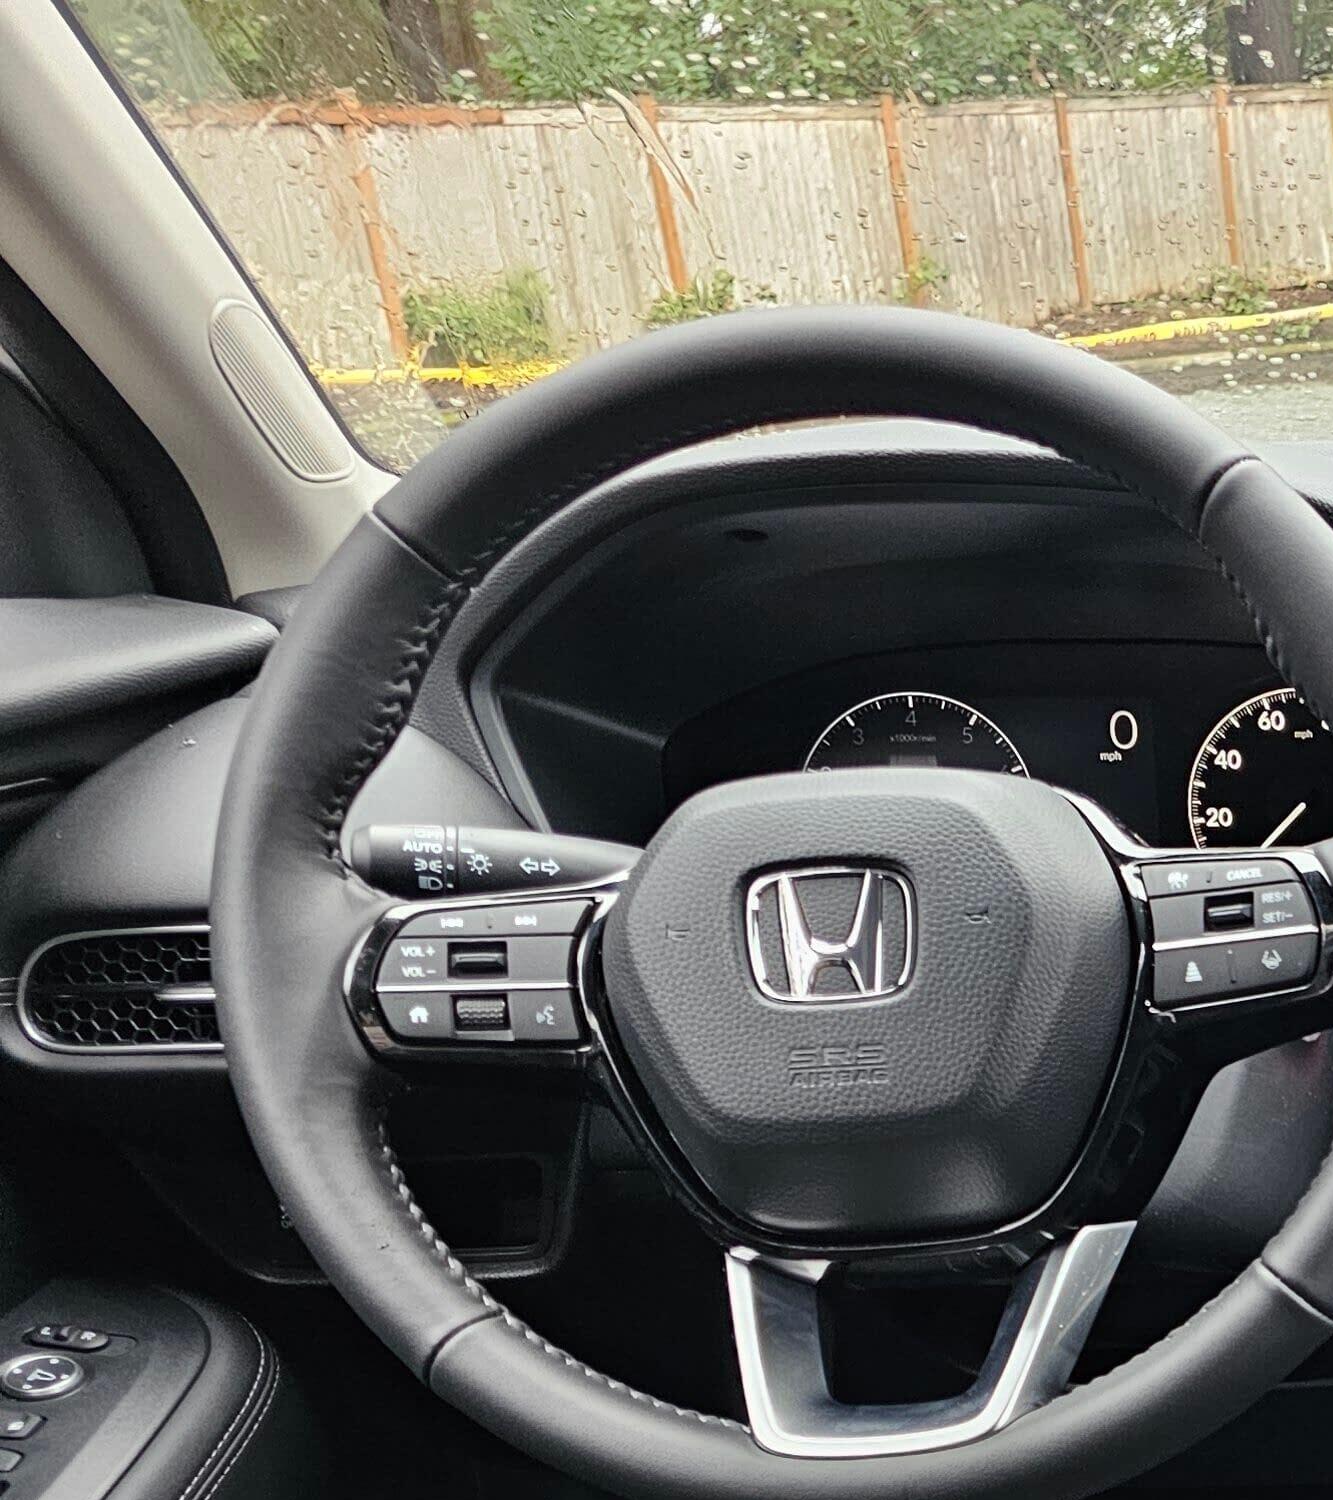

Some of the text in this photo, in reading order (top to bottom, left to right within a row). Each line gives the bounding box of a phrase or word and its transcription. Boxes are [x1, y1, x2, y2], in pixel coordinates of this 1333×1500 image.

[905, 710, 917, 727] 4
[1257, 709, 1286, 732] 60
[852, 729, 865, 746] 3
[962, 727, 974, 744] 5
[1109, 709, 1138, 751] 0
[1294, 729, 1314, 740] mph
[1100, 751, 1122, 762] mph
[1214, 749, 1242, 770] 40
[1205, 807, 1233, 828] 20
[403, 840, 443, 854] AUTO
[1226, 868, 1263, 881] CANCEL
